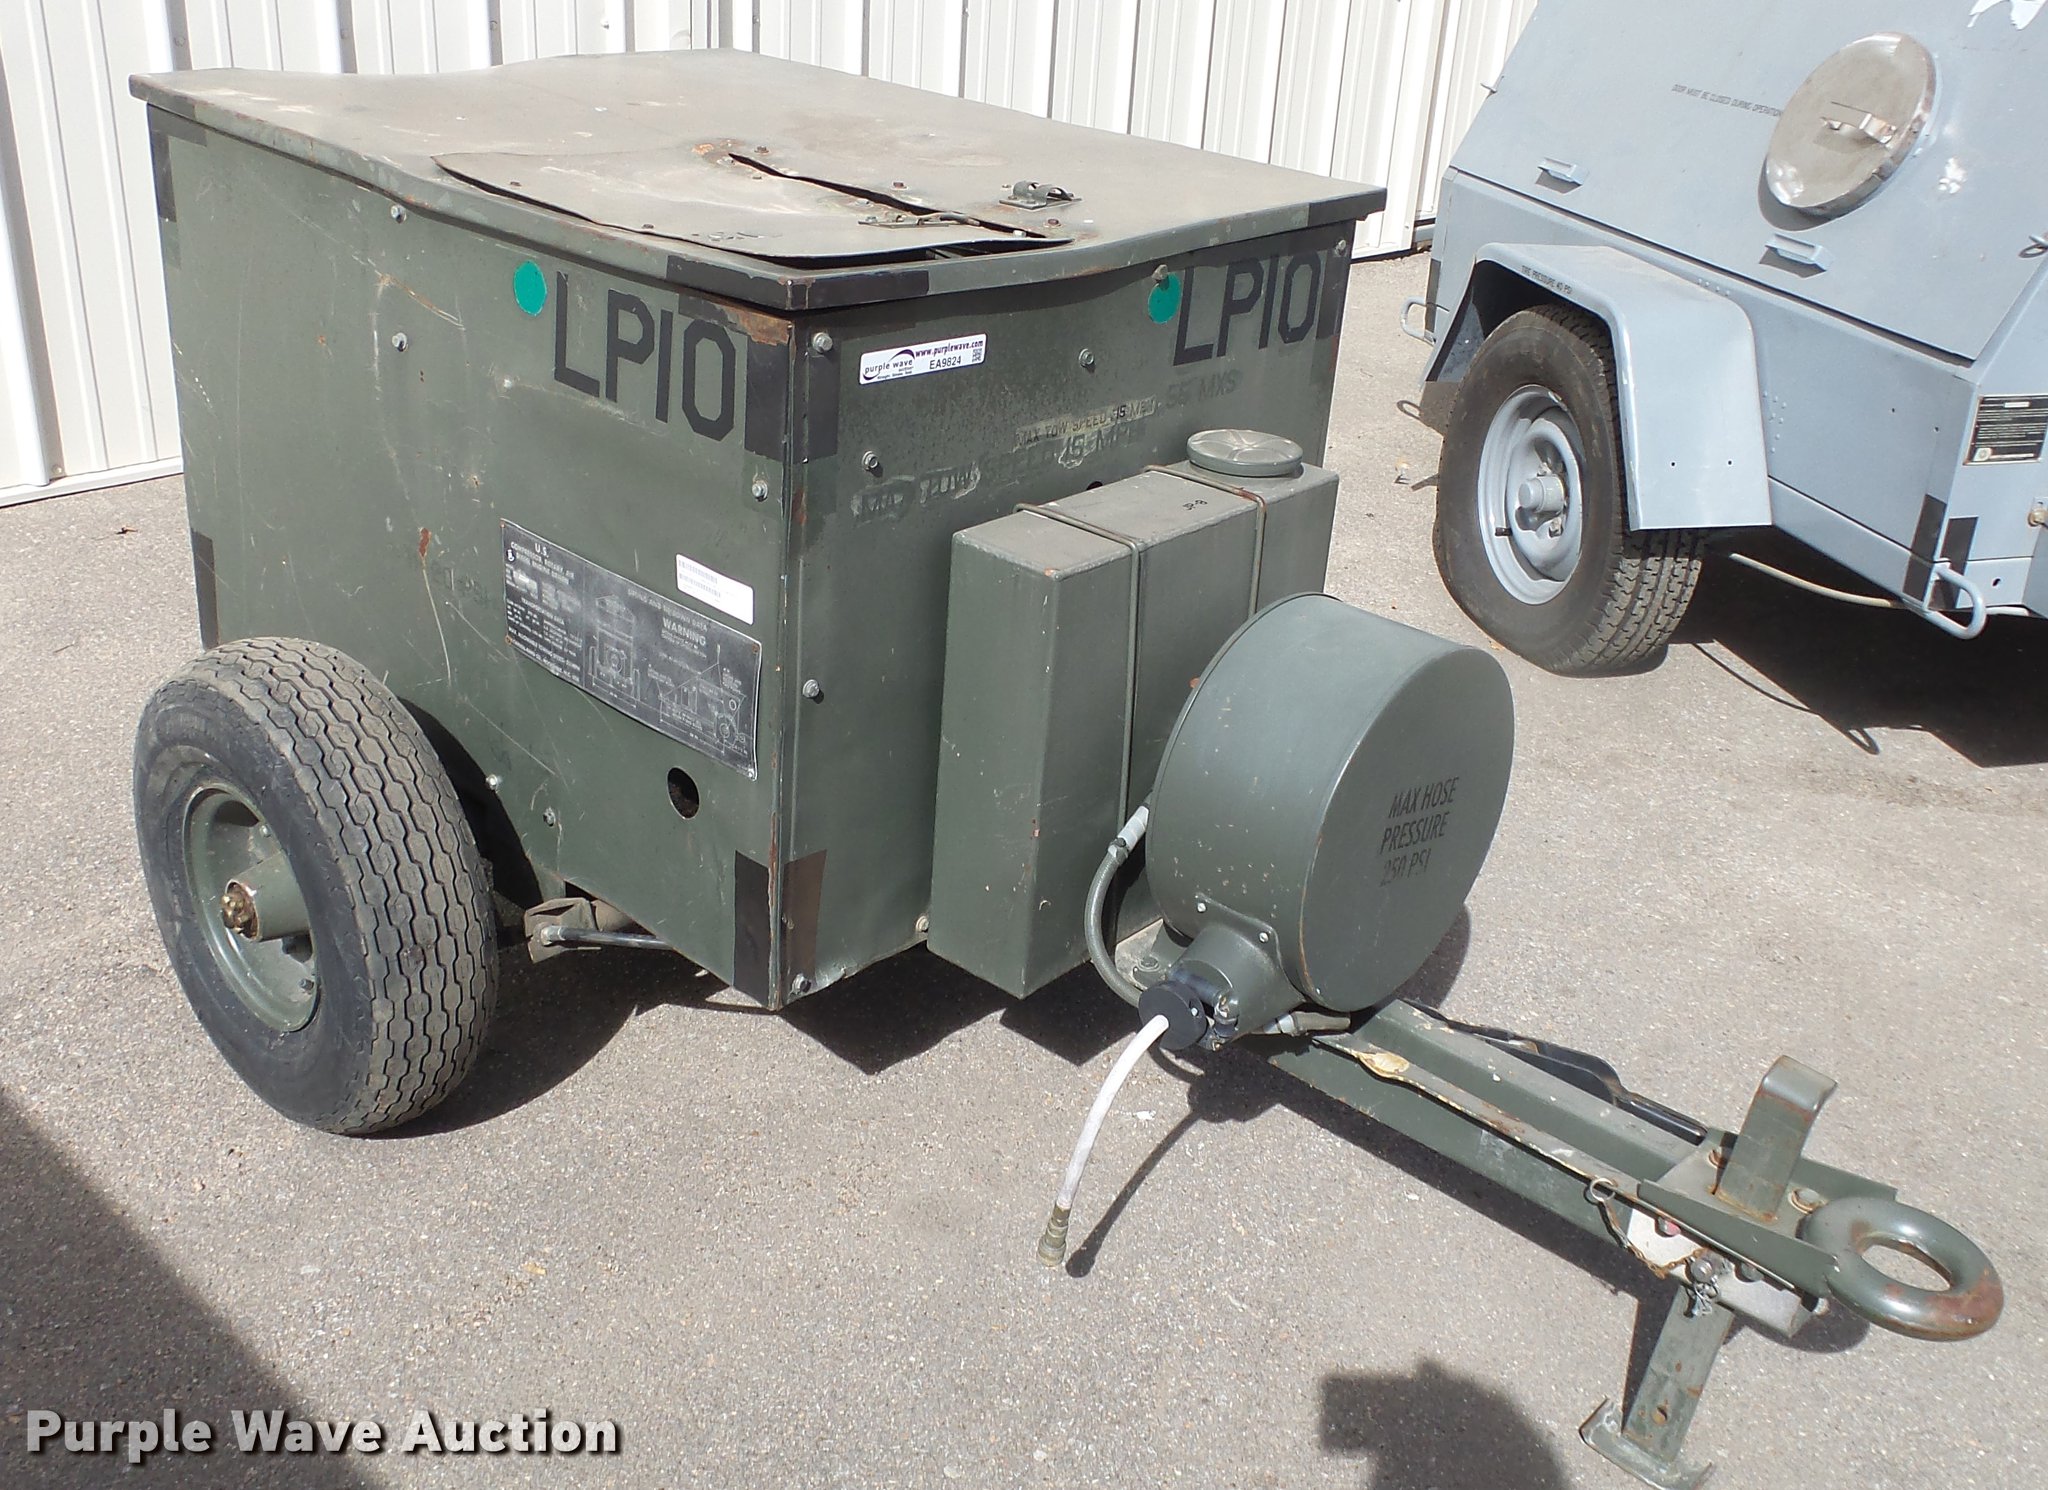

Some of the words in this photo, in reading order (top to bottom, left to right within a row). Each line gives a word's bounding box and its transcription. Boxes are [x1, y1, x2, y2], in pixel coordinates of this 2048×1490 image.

[915, 340, 984, 358] www.purplewave.com
[864, 361, 891, 375] purple
[892, 359, 913, 369] wave
[929, 355, 962, 370] EA9824
[534, 542, 549, 559] U.S.
[661, 616, 707, 647] WARNING
[1387, 788, 1422, 819] MAX
[1421, 776, 1460, 811] HOSE
[1379, 811, 1451, 855] PRESSURE
[1407, 848, 1432, 878] PSI
